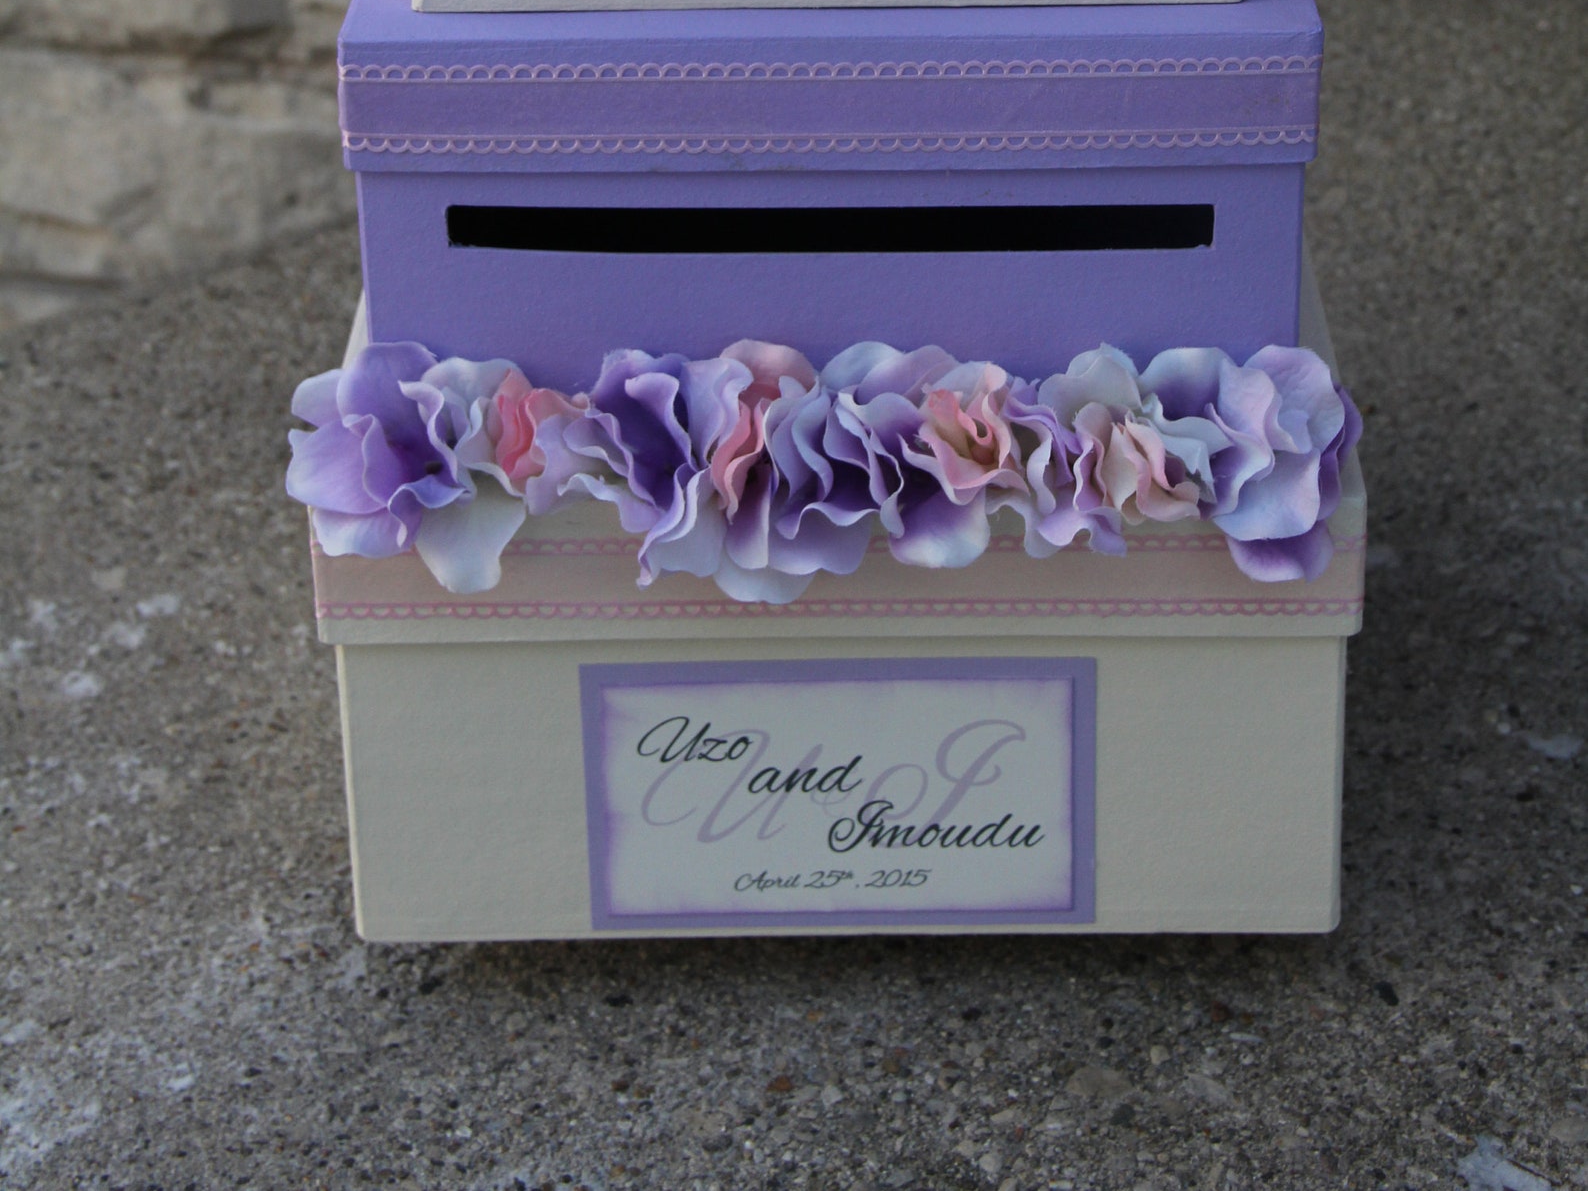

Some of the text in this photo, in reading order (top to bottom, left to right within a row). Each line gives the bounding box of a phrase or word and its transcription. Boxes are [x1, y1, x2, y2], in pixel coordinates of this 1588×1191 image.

[637, 716, 753, 763] Uzo
[748, 755, 864, 794] and
[828, 800, 1046, 853] Imoudu
[734, 870, 802, 892] April
[864, 869, 932, 889] 2015
